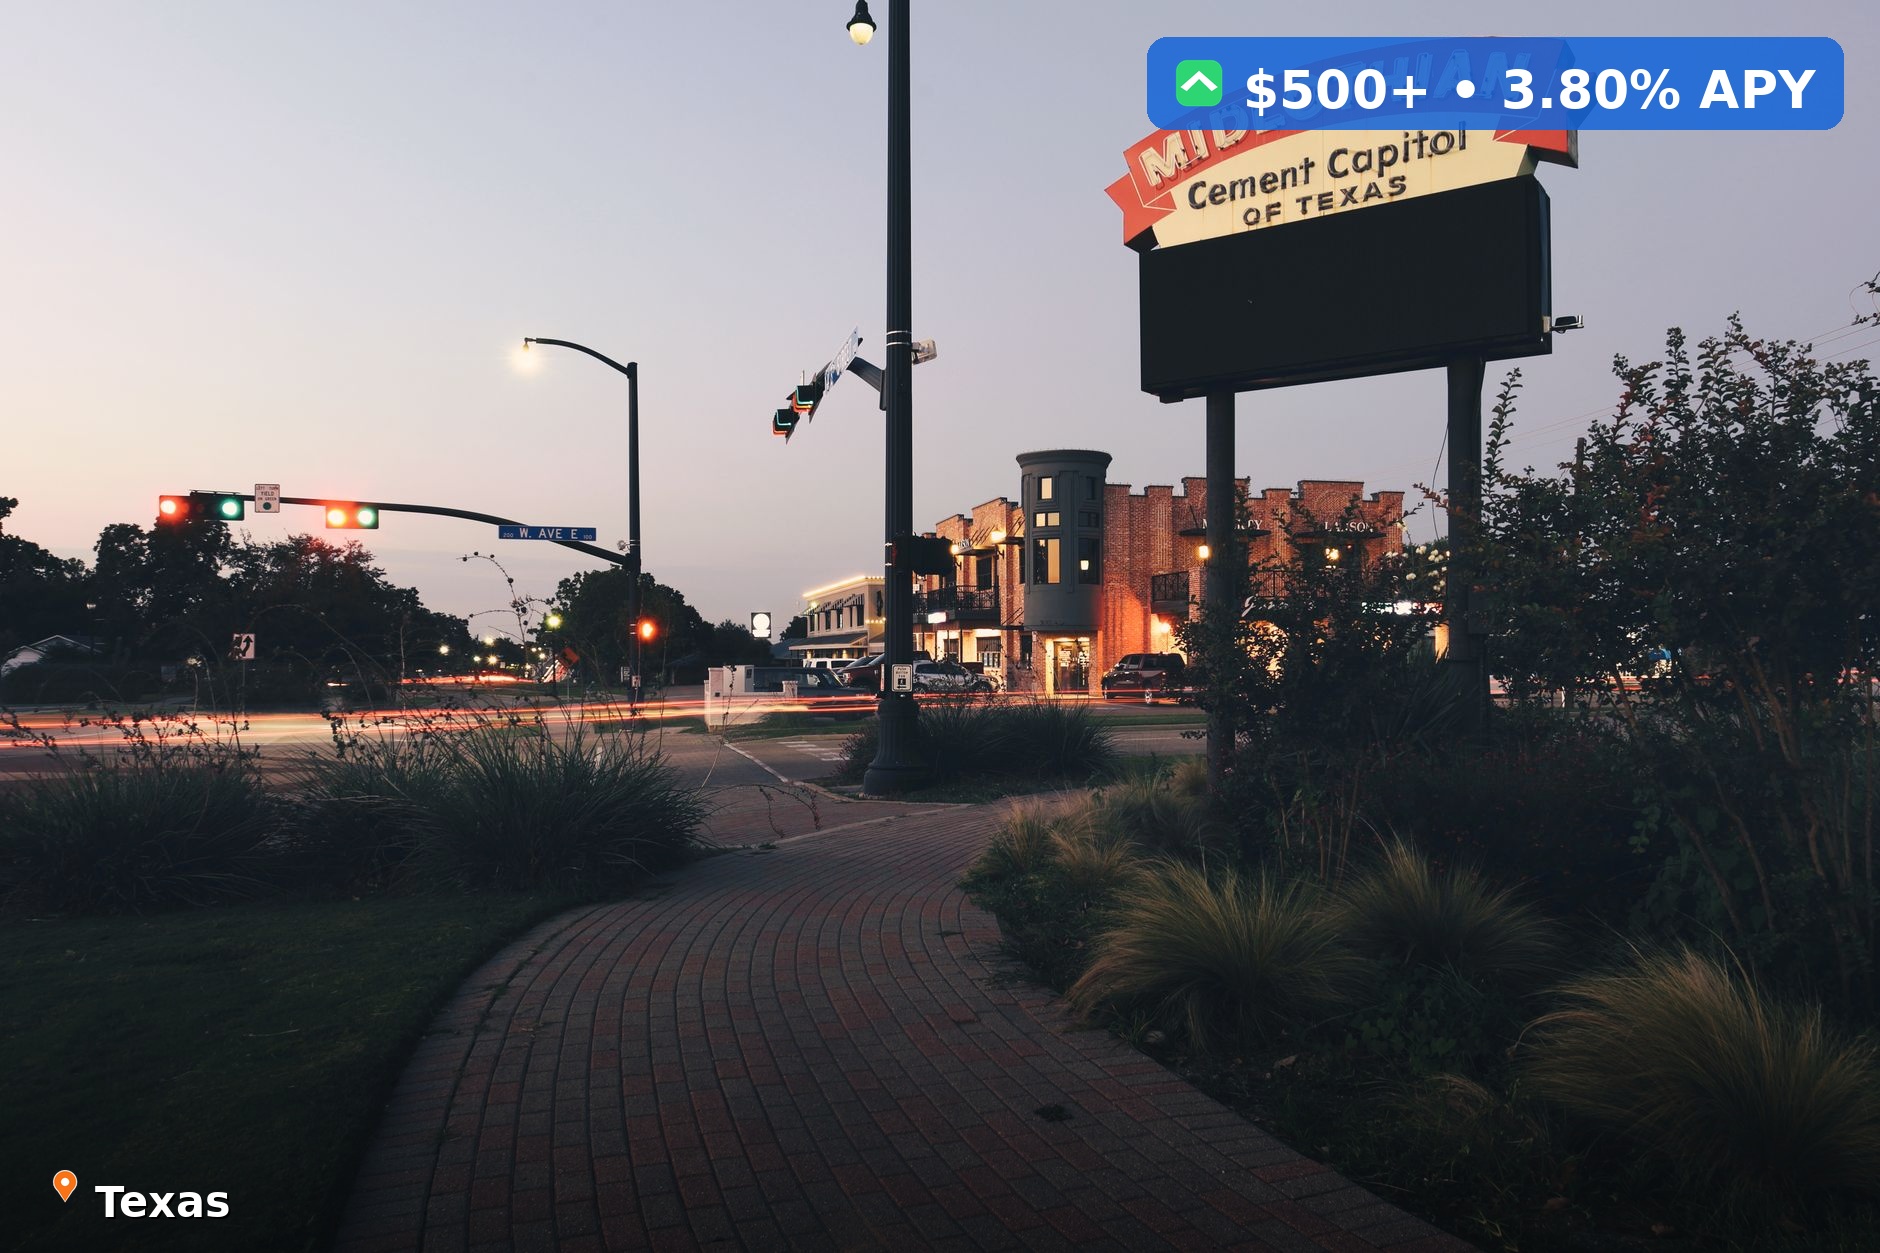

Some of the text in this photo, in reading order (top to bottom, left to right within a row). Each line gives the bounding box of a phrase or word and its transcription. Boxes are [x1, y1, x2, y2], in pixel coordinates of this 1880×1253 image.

[1188, 120, 1467, 210] Cement Capitol
[1242, 174, 1407, 226] OF TEXAS
[520, 528, 532, 538] W.
[538, 528, 562, 538] AVE
[571, 529, 578, 539] E
[1324, 521, 1374, 533] LASON
